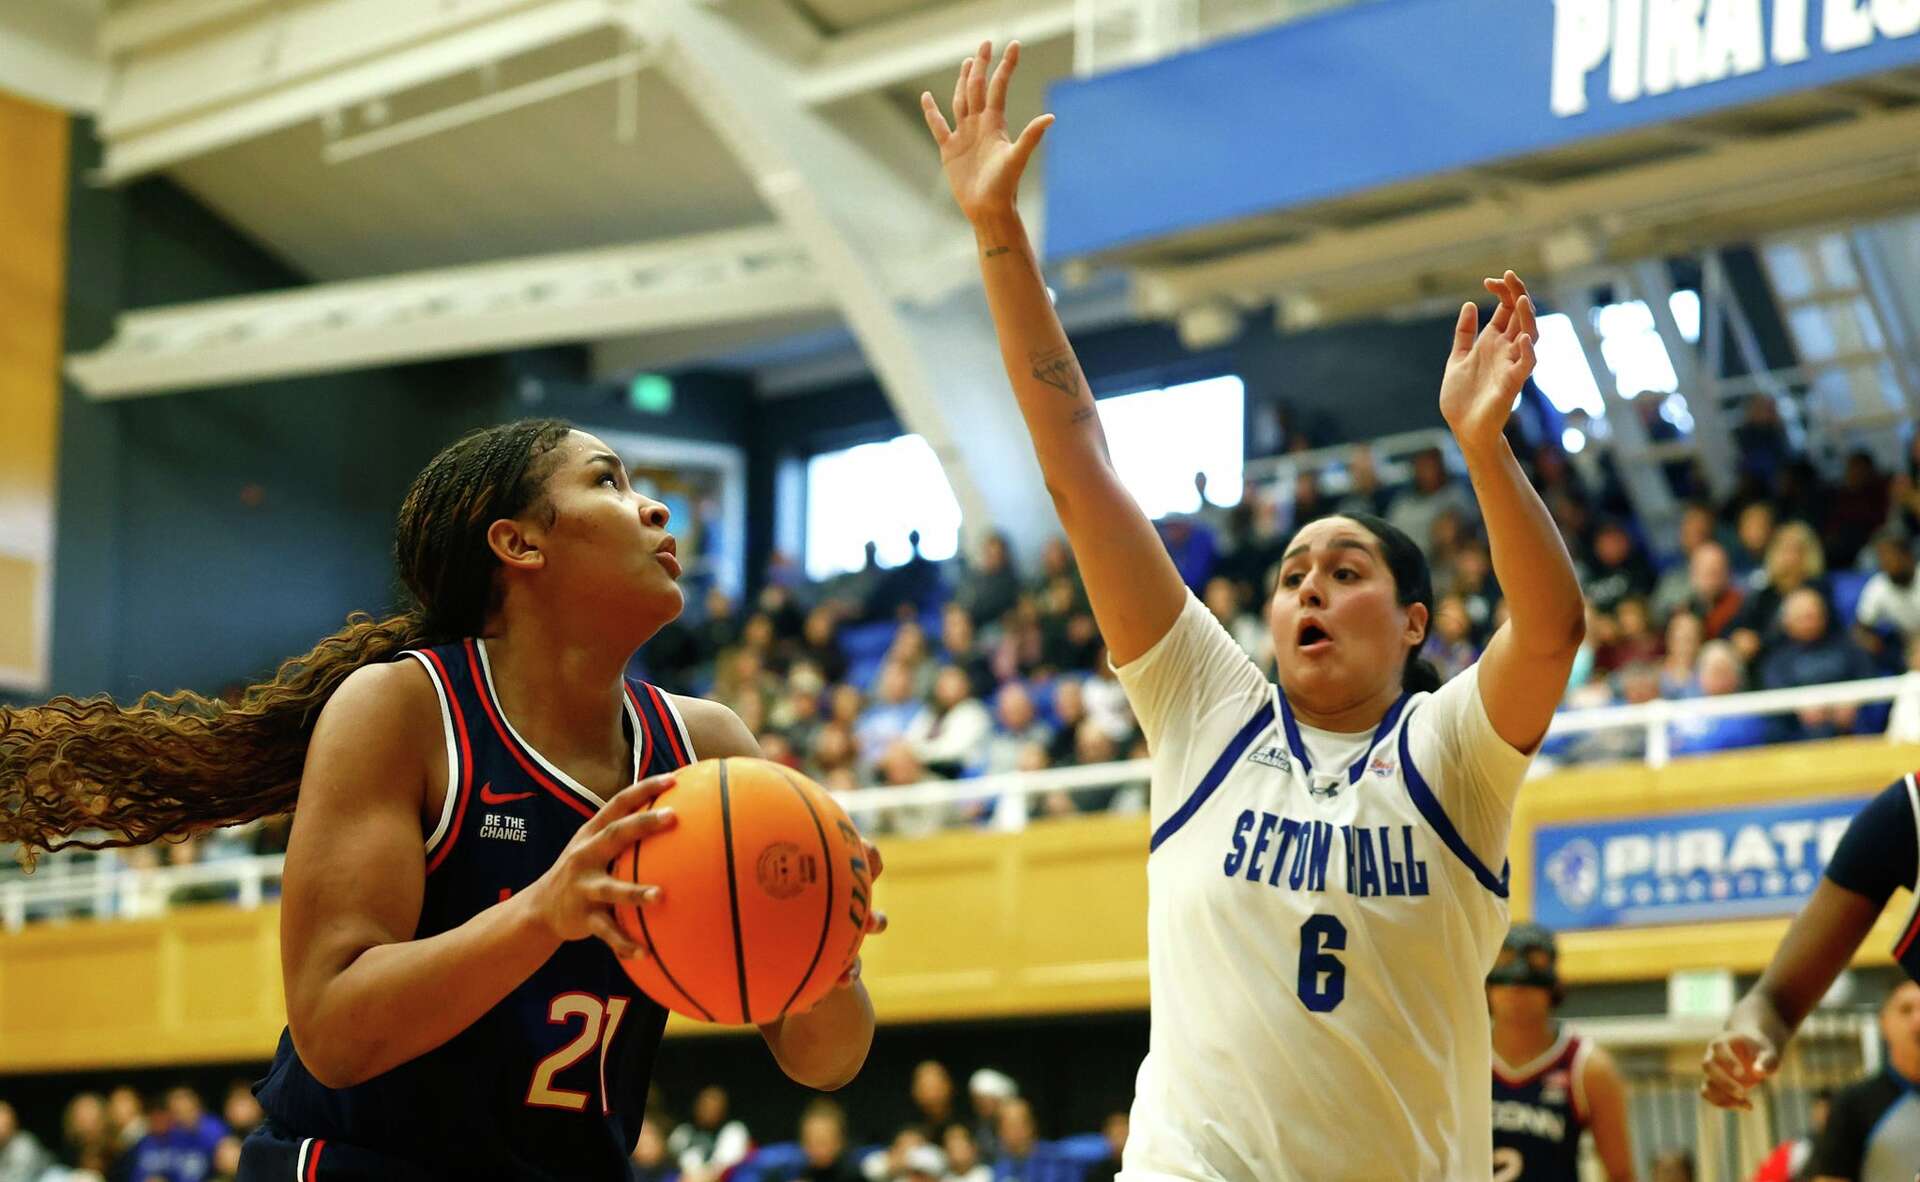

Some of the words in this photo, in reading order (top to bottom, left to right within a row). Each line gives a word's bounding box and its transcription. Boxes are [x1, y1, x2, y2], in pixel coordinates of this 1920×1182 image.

[480, 826, 528, 842] CHANGE
[485, 814, 501, 827] BE
[504, 815, 526, 829] THE
[1223, 808, 1333, 892] SETON
[1340, 824, 1429, 898] HALL
[1297, 913, 1347, 1012] 6
[524, 991, 631, 1118] 21
